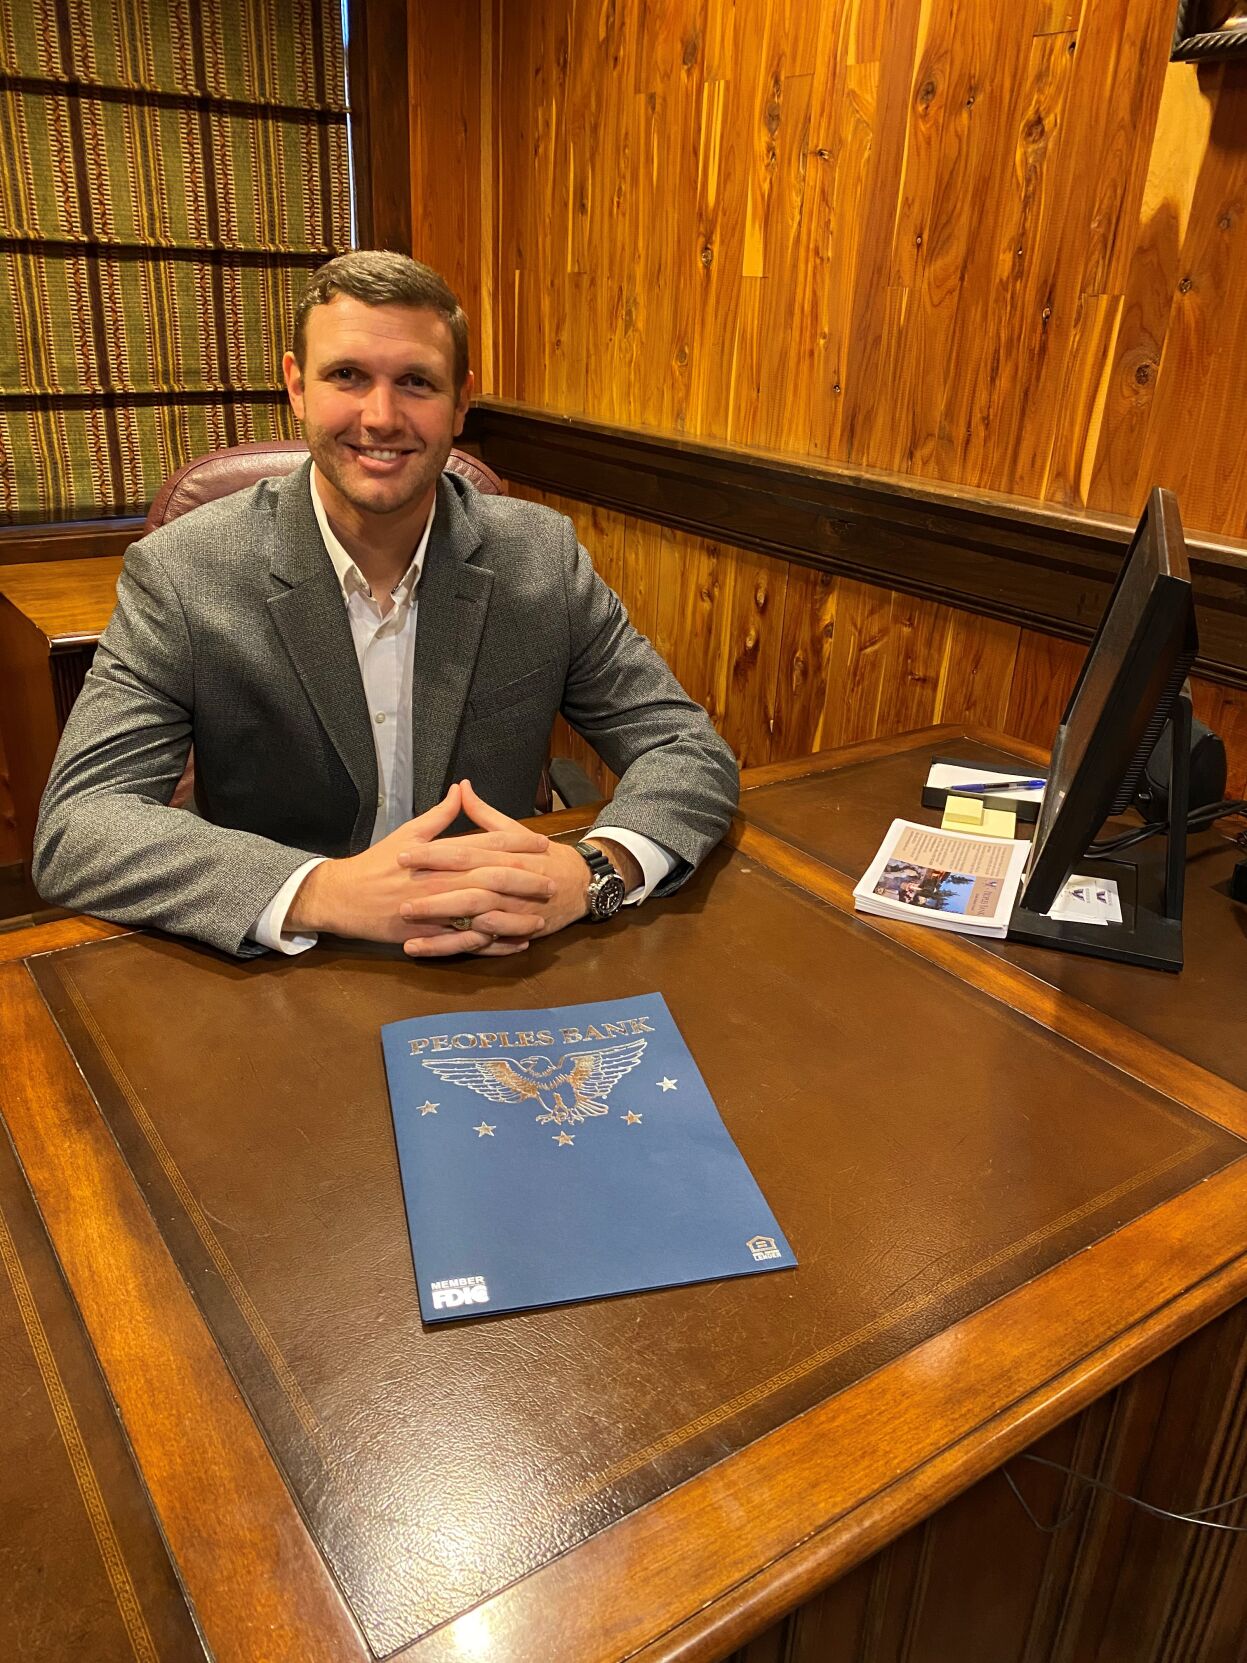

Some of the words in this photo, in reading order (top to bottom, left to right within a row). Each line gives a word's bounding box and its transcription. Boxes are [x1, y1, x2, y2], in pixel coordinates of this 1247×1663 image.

[408, 1030, 554, 1055] PEOPLES
[560, 1016, 656, 1044] BANK
[431, 1276, 485, 1290] MEMBER
[432, 1285, 490, 1309] FDIC
